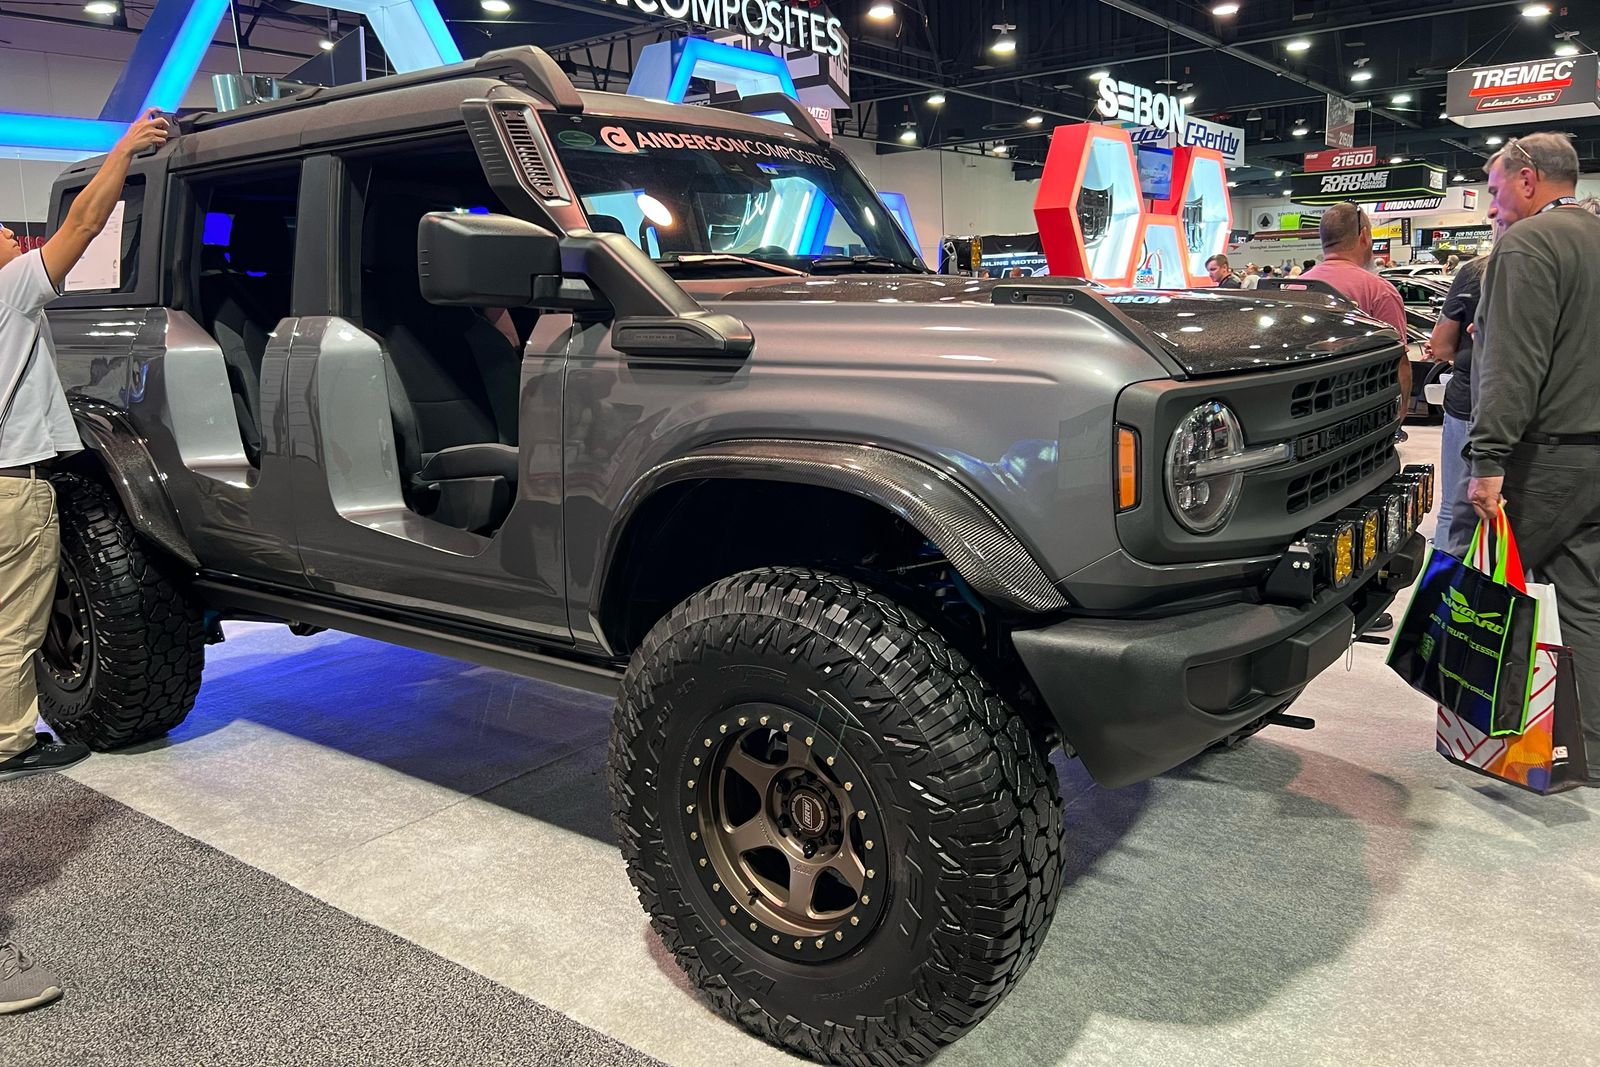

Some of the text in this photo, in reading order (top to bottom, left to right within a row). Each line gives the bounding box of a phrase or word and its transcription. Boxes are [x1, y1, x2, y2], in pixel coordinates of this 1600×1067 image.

[1472, 61, 1574, 89] TREMEC
[1331, 153, 1374, 168] 21500
[1320, 171, 1390, 186] FORTUNE
[1320, 182, 1361, 193] AUTO
